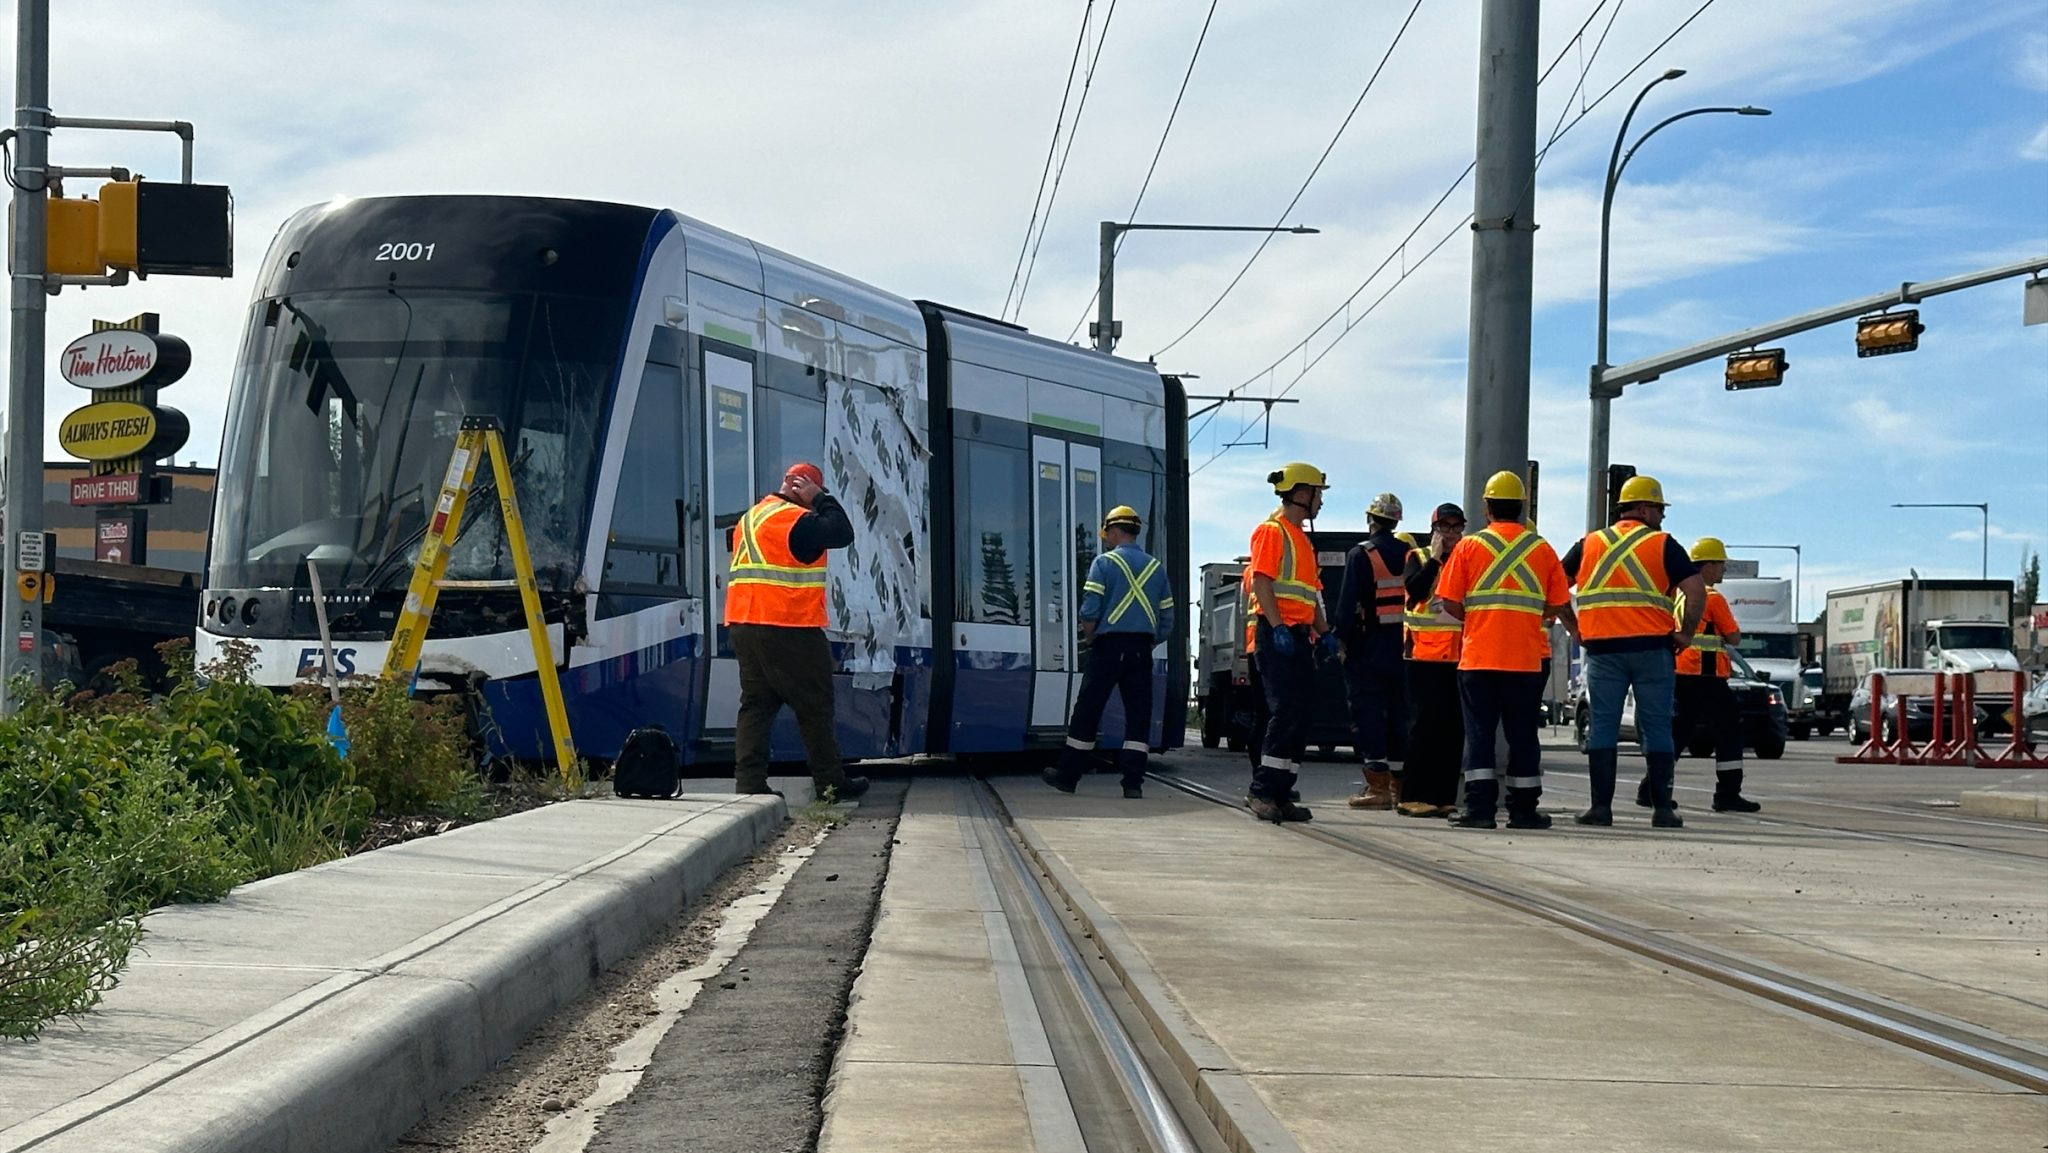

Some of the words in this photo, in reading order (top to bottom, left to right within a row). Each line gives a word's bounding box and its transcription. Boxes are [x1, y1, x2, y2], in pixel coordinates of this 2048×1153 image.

[375, 243, 435, 261] 2001
[68, 346, 95, 379] Tim
[96, 343, 151, 375] Hortons
[64, 421, 109, 443] ALWAYS
[110, 416, 150, 438] FRESH
[74, 483, 105, 500] DRIVE
[108, 481, 137, 497] THRU
[296, 648, 357, 678] ETS
